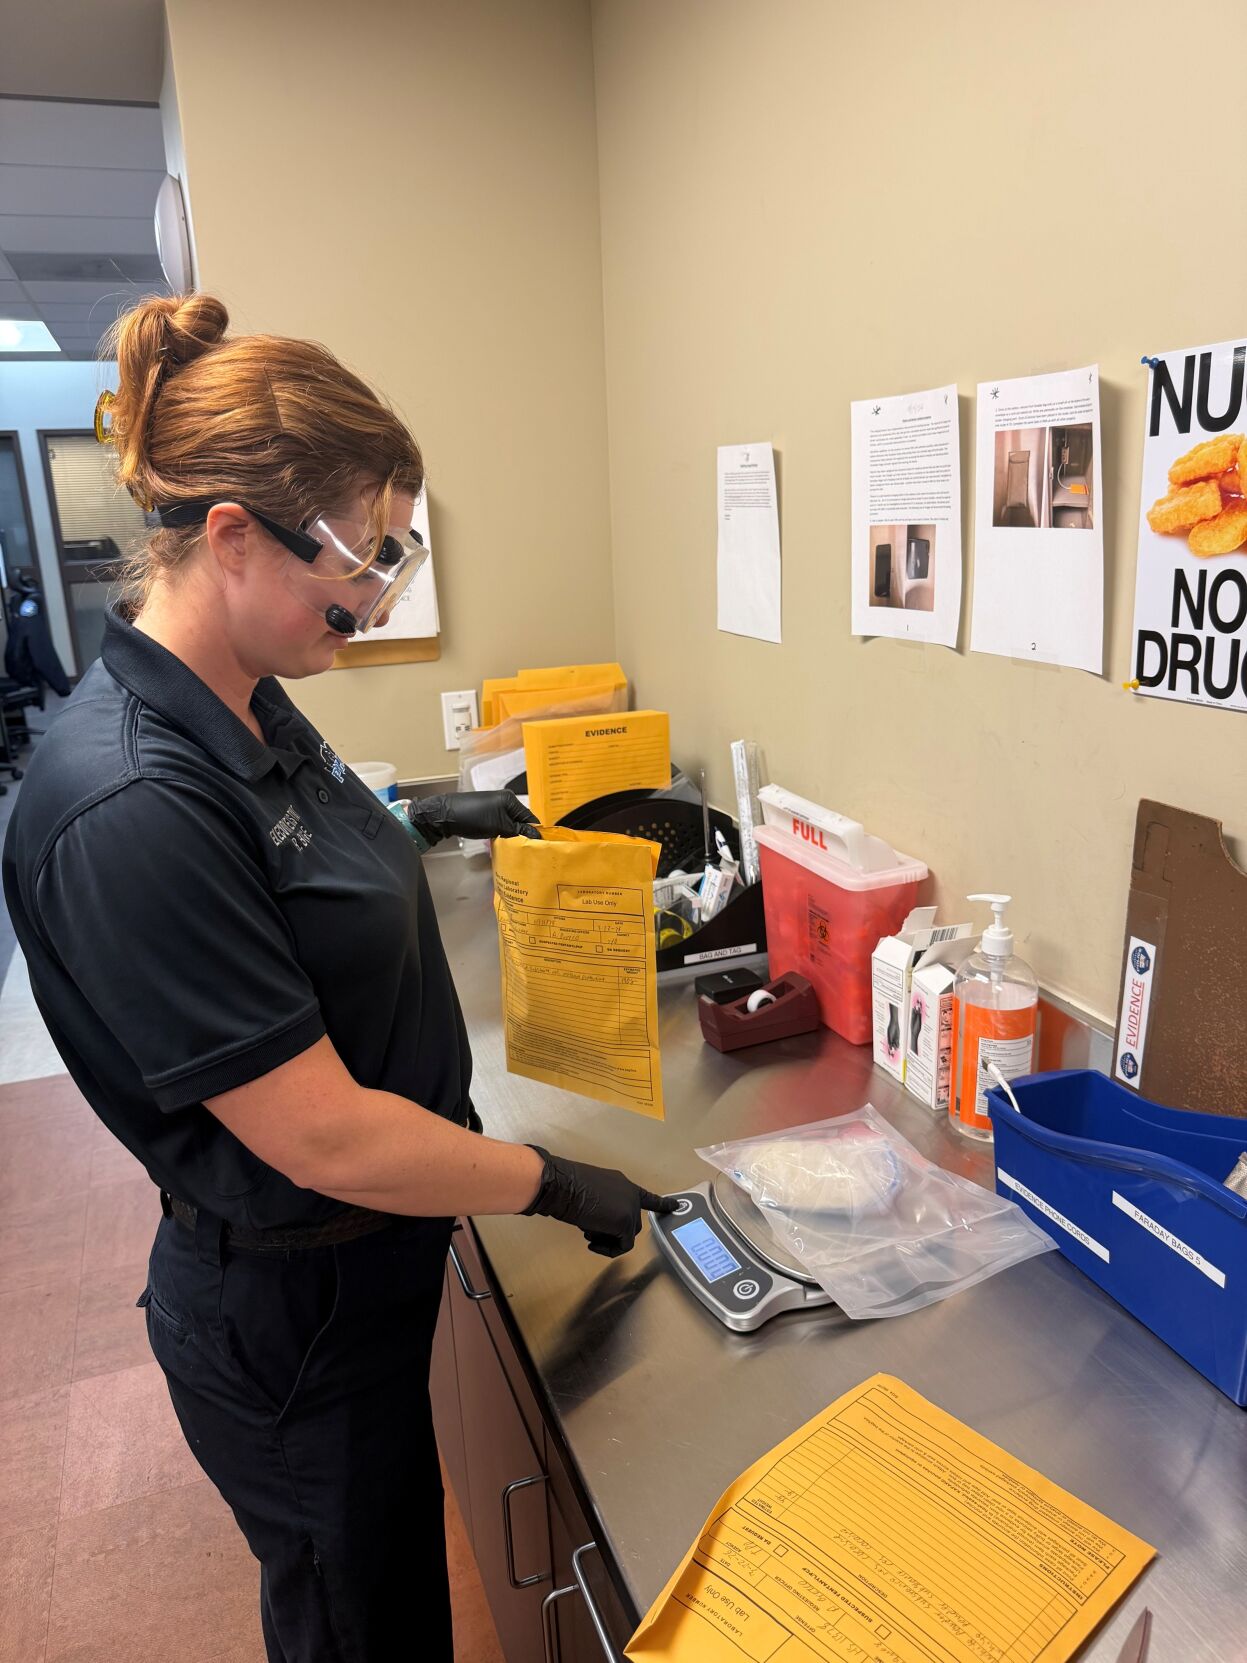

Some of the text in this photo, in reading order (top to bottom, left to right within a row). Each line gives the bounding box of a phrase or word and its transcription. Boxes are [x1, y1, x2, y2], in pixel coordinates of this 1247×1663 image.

[1149, 345, 1247, 437] NU
[1030, 641, 1037, 651] 2
[1135, 629, 1247, 700] DRU
[585, 726, 628, 738] EVIDENCE
[792, 818, 828, 851] FULL
[582, 898, 592, 906] Lab
[604, 899, 618, 908] Only
[699, 948, 742, 960] BAG AND TAG
[1126, 978, 1144, 1048] EVIDENCE
[1014, 1181, 1090, 1245] EVIDENCE PHONE CORDS
[1134, 1209, 1201, 1266] FARADAY BAGS 5
[750, 1496, 773, 1515] ESTIMATED
[741, 1522, 771, 1546] DA REQUEST
[719, 1557, 731, 1567] DATE
[1068, 1537, 1110, 1569] PLEASE NOTE
[773, 1574, 821, 1611] REQUESTING OFFICER
[799, 1565, 874, 1623] SUSPECTED FENTANYL/PCP
[856, 1572, 889, 1599] DESCRIPTION
[1036, 1562, 1085, 1600] INSTRUCTIONS
[684, 1591, 744, 1637] LABORATORY NUMBER
[702, 1582, 750, 1622] Lab Use Only
[793, 1613, 817, 1633] OFFENSE
